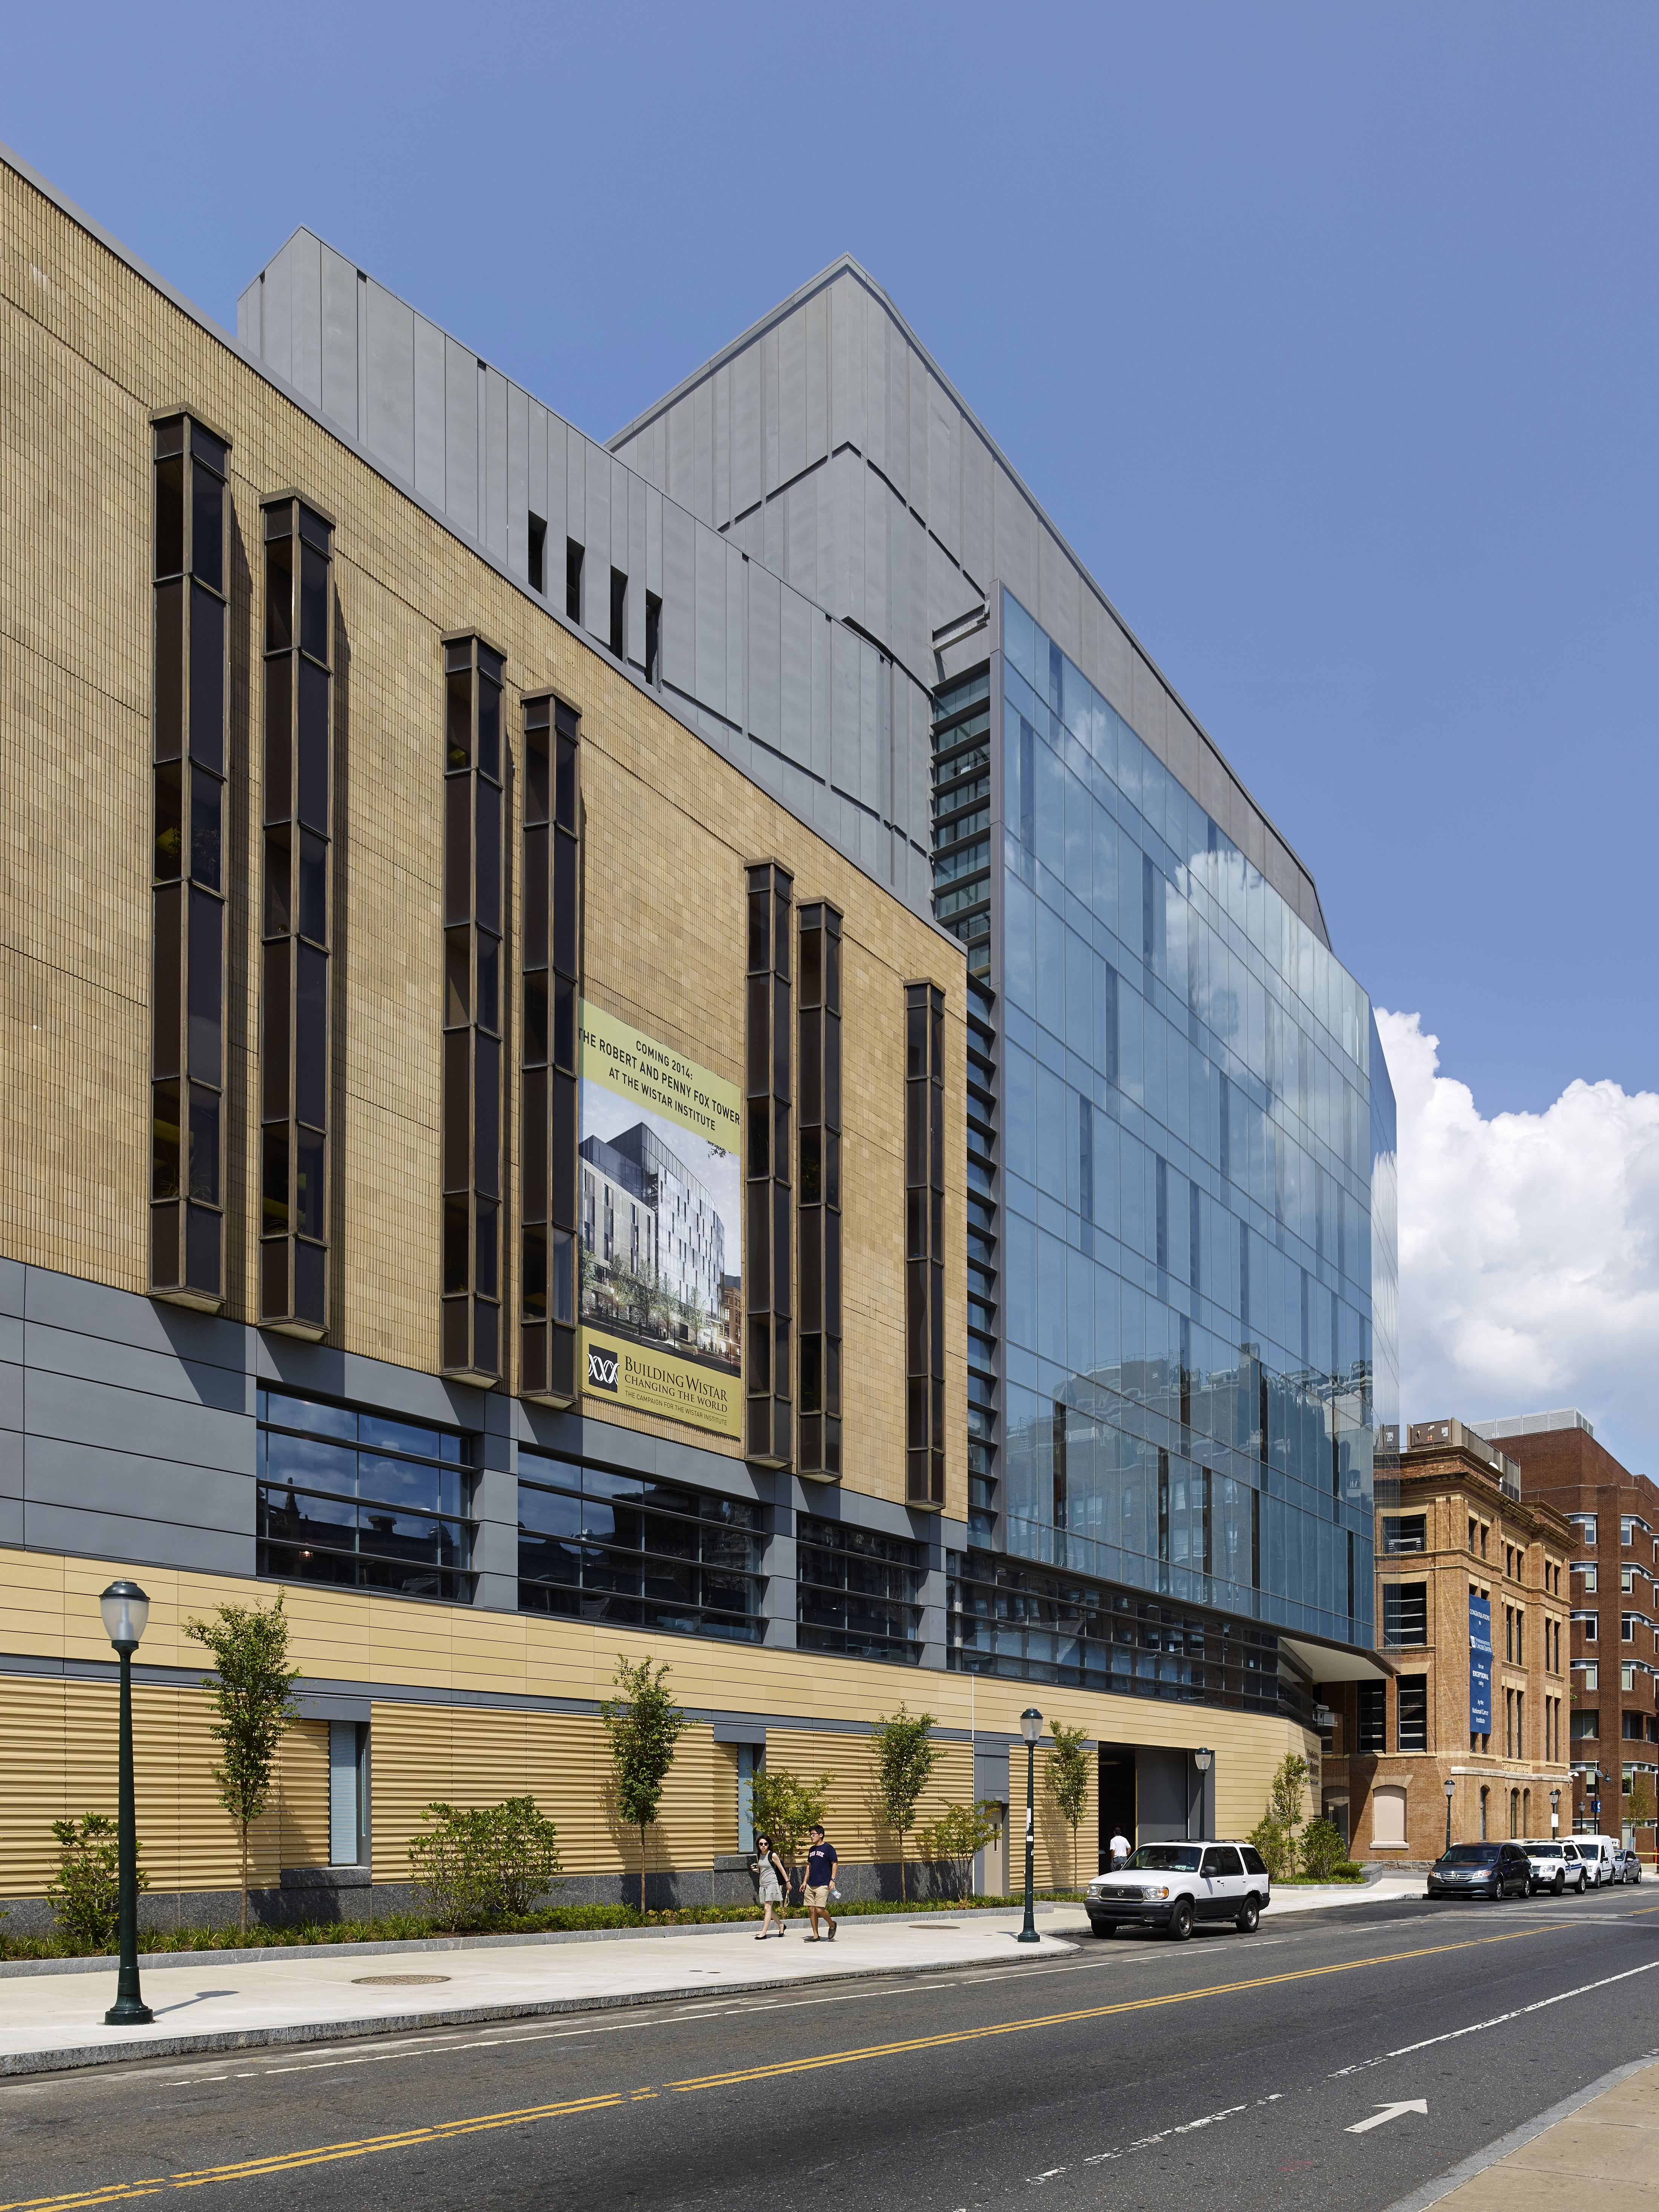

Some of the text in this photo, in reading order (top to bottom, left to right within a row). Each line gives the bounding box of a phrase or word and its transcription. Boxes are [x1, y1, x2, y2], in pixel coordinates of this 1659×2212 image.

[579, 1027, 740, 1125] THE ROBERT AND PENNY FOX TOWER
[636, 1041, 693, 1080] COMING 2014:
[609, 1067, 715, 1131] AT THE WISTAR INSTITUTE
[624, 1355, 728, 1402] BUILDING WISTAR
[625, 1374, 727, 1412] CHANGING THE WORLD
[625, 1390, 635, 1399] THE
[637, 1394, 663, 1406] CAMPAIGN
[685, 1408, 703, 1418] WISTAR
[704, 1414, 727, 1426] INSTITUTE
[1470, 1609, 1490, 1621] CONGRATULATIONS
[1473, 1670, 1489, 1680] EXCEPTIONAL
